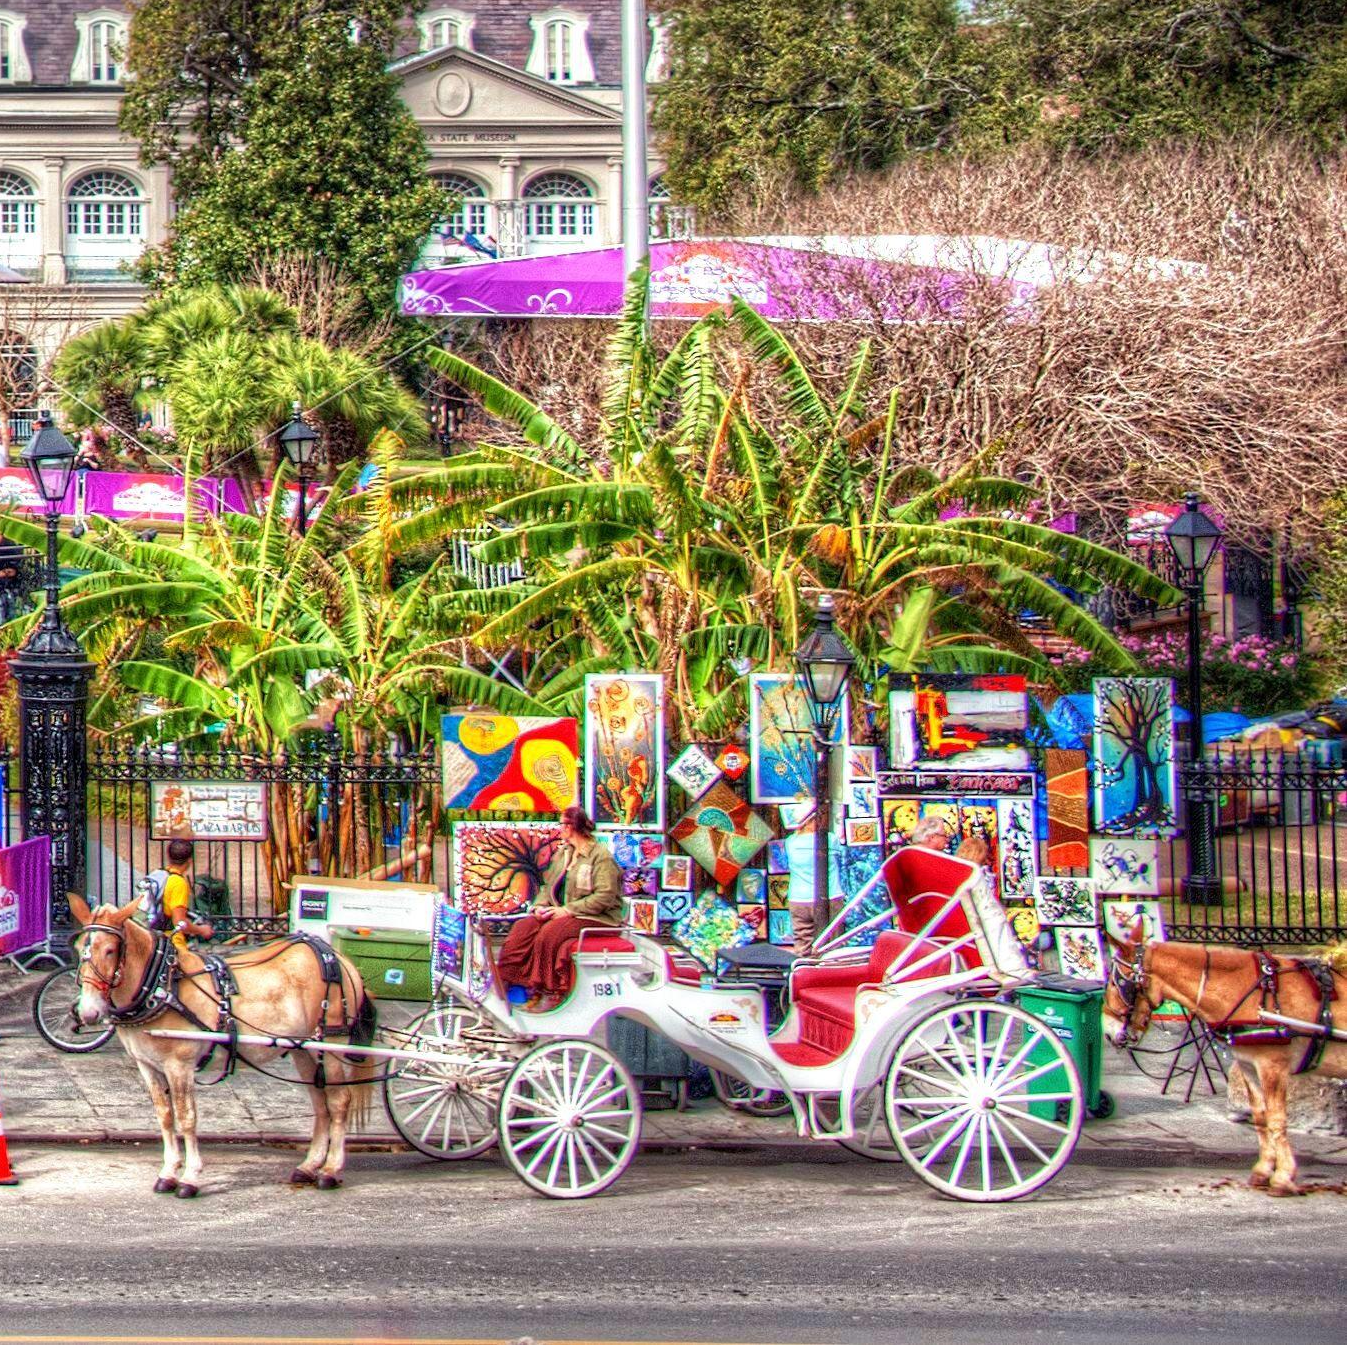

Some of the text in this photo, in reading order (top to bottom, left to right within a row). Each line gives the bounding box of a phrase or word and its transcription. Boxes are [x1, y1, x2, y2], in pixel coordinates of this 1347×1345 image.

[440, 134, 468, 142] STATE
[474, 134, 516, 142] MUSEUM
[593, 982, 621, 997] 1981
